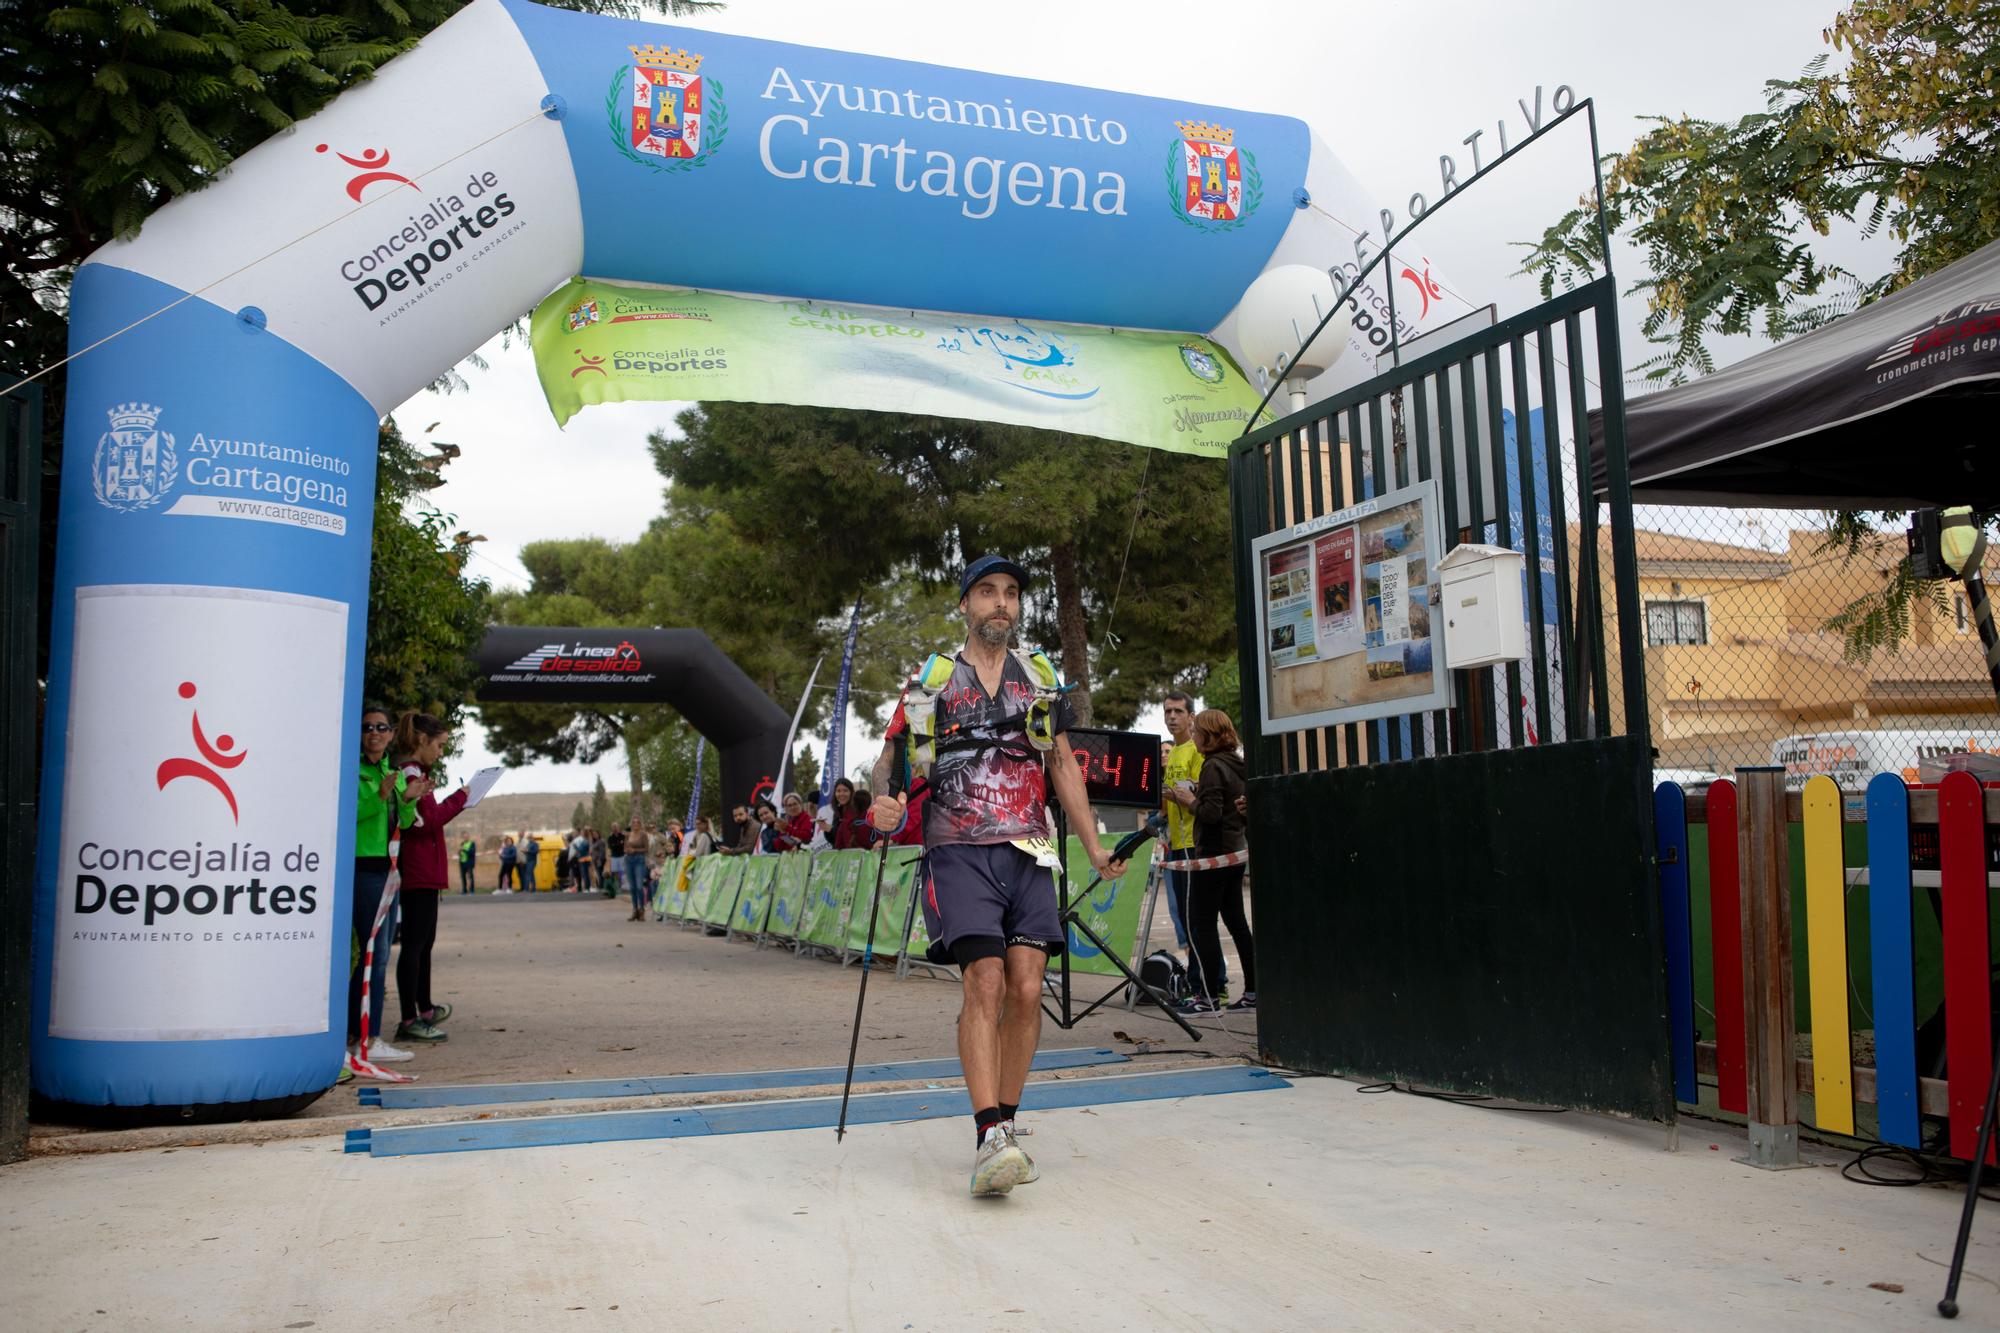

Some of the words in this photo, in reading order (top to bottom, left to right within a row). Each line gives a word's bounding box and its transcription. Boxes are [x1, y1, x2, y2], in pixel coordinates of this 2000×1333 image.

[761, 67, 1127, 145] Ayuntamiento
[760, 114, 1127, 219] Cartagena
[341, 196, 464, 282] Concejalía
[466, 171, 498, 198] de
[353, 193, 515, 311] Deportes
[379, 272, 453, 326] AYUNTAMIENTO
[456, 261, 469, 272] DE
[472, 220, 526, 261] CARTAGENA
[789, 316, 925, 339] SENDERO
[614, 358, 728, 373] Deportes
[705, 347, 726, 357] de
[1877, 344, 1966, 384] cronometrajes
[1973, 337, 2000, 352] dep
[188, 433, 349, 476] Ayuntamiento
[186, 457, 348, 508] Cartagena
[218, 501, 344, 531] www.cartagena.es
[78, 841, 270, 878] Concejalía
[283, 844, 319, 872] de
[74, 874, 317, 926] Deportes
[73, 931, 193, 942] AYUNTAMIENTO
[203, 932, 223, 942] DE
[233, 931, 315, 941] CARTAGENA
